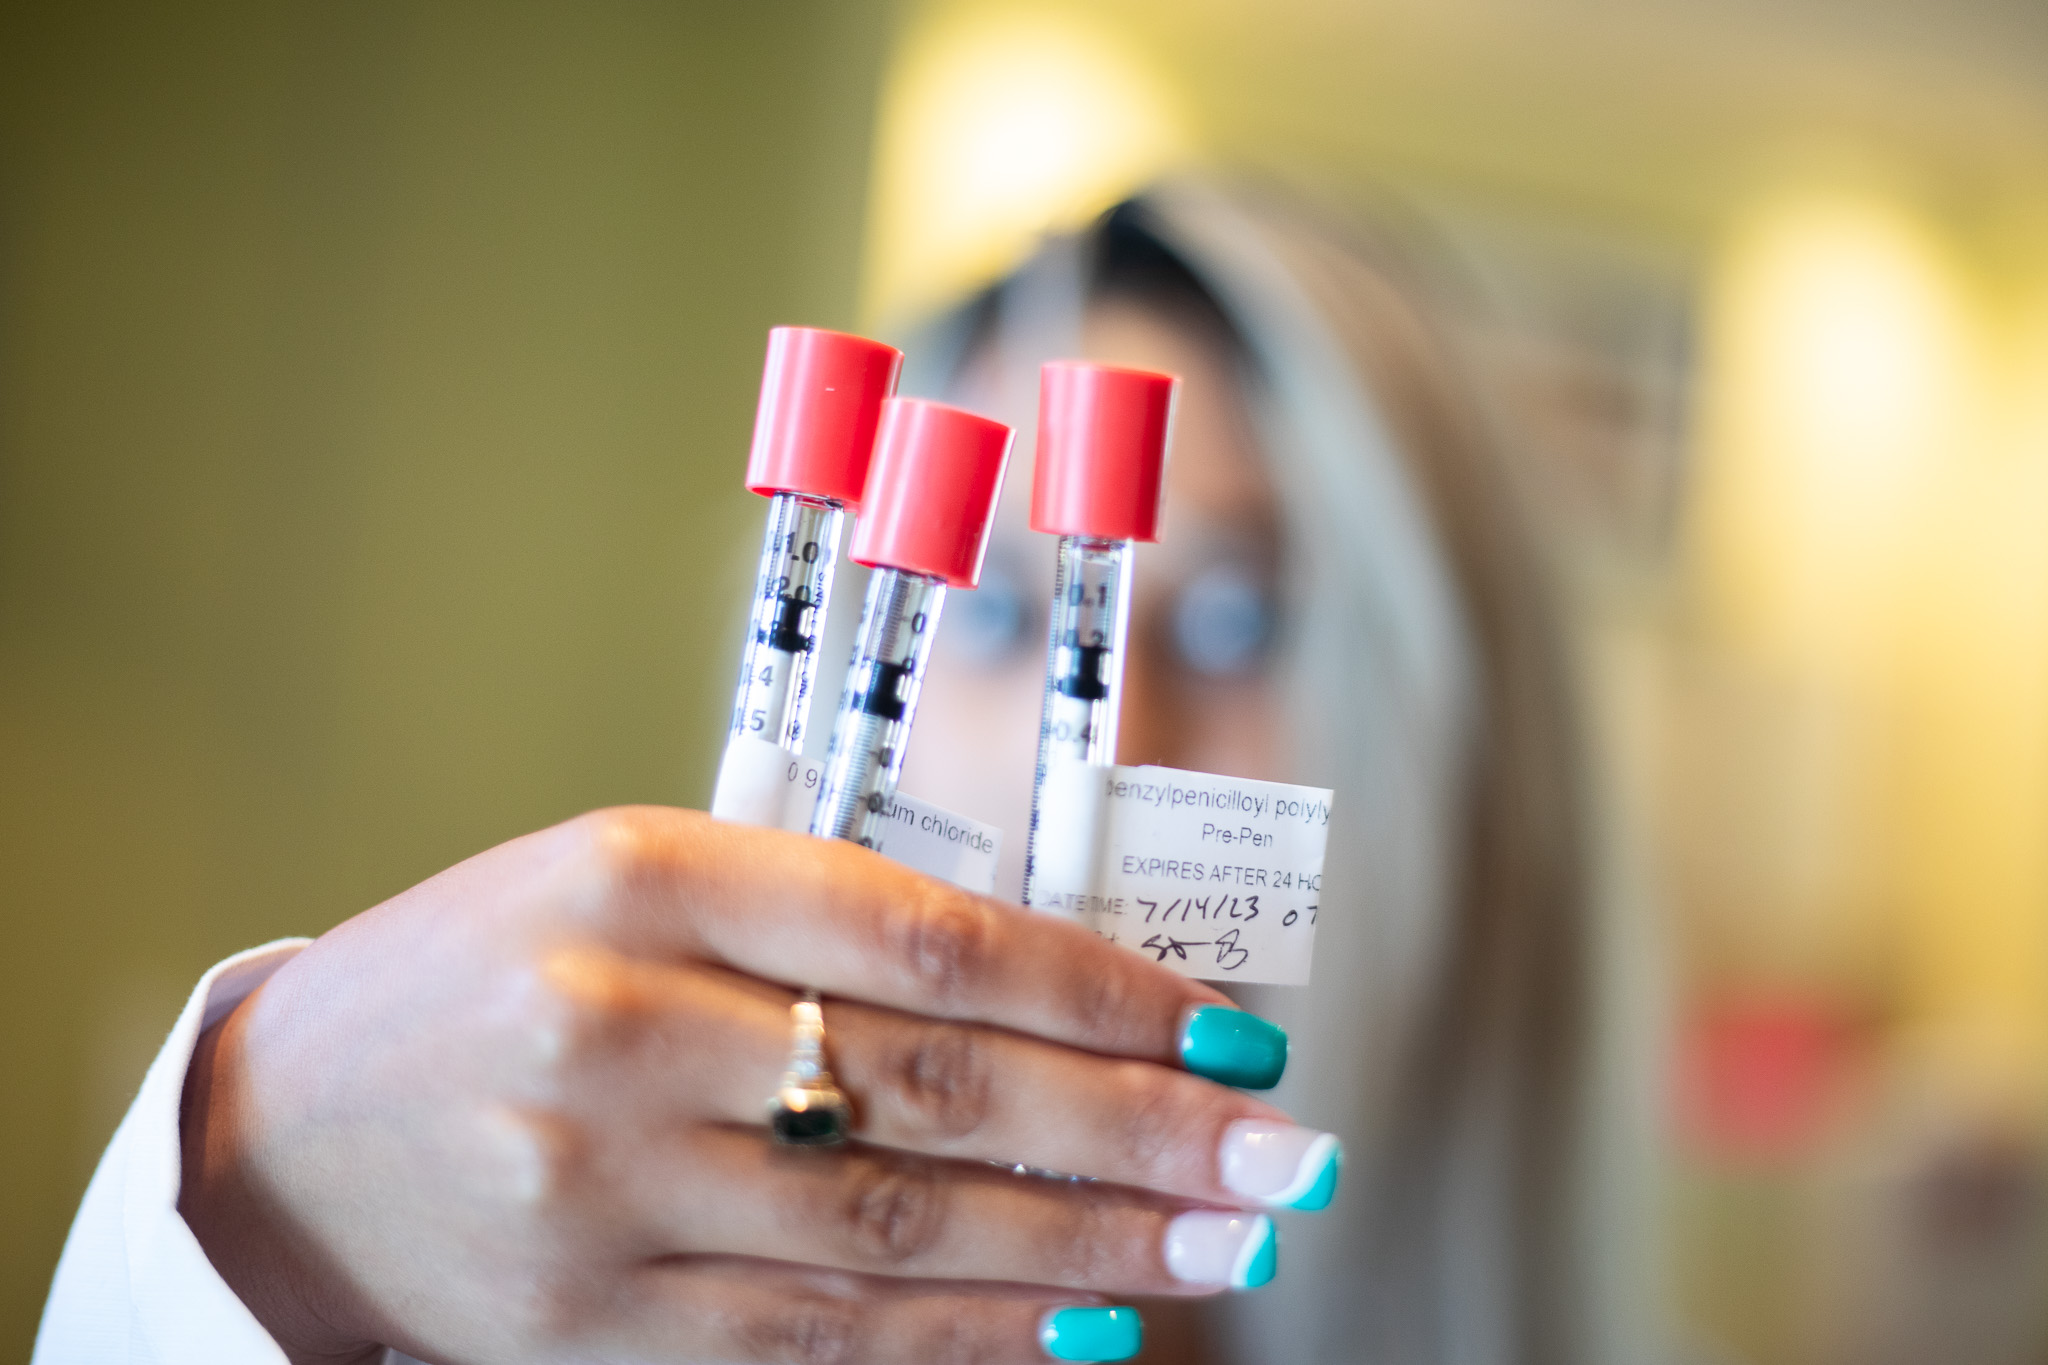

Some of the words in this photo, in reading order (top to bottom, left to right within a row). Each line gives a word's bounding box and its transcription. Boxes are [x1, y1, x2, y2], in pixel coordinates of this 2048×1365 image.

[921, 813, 994, 854] chloride
[1202, 823, 1273, 847] Pre-Pen
[1122, 855, 1204, 881] EXPIRES
[1209, 866, 1267, 888] AFTER
[1273, 870, 1291, 888] 24
[1136, 893, 1260, 923] 7/14/23
